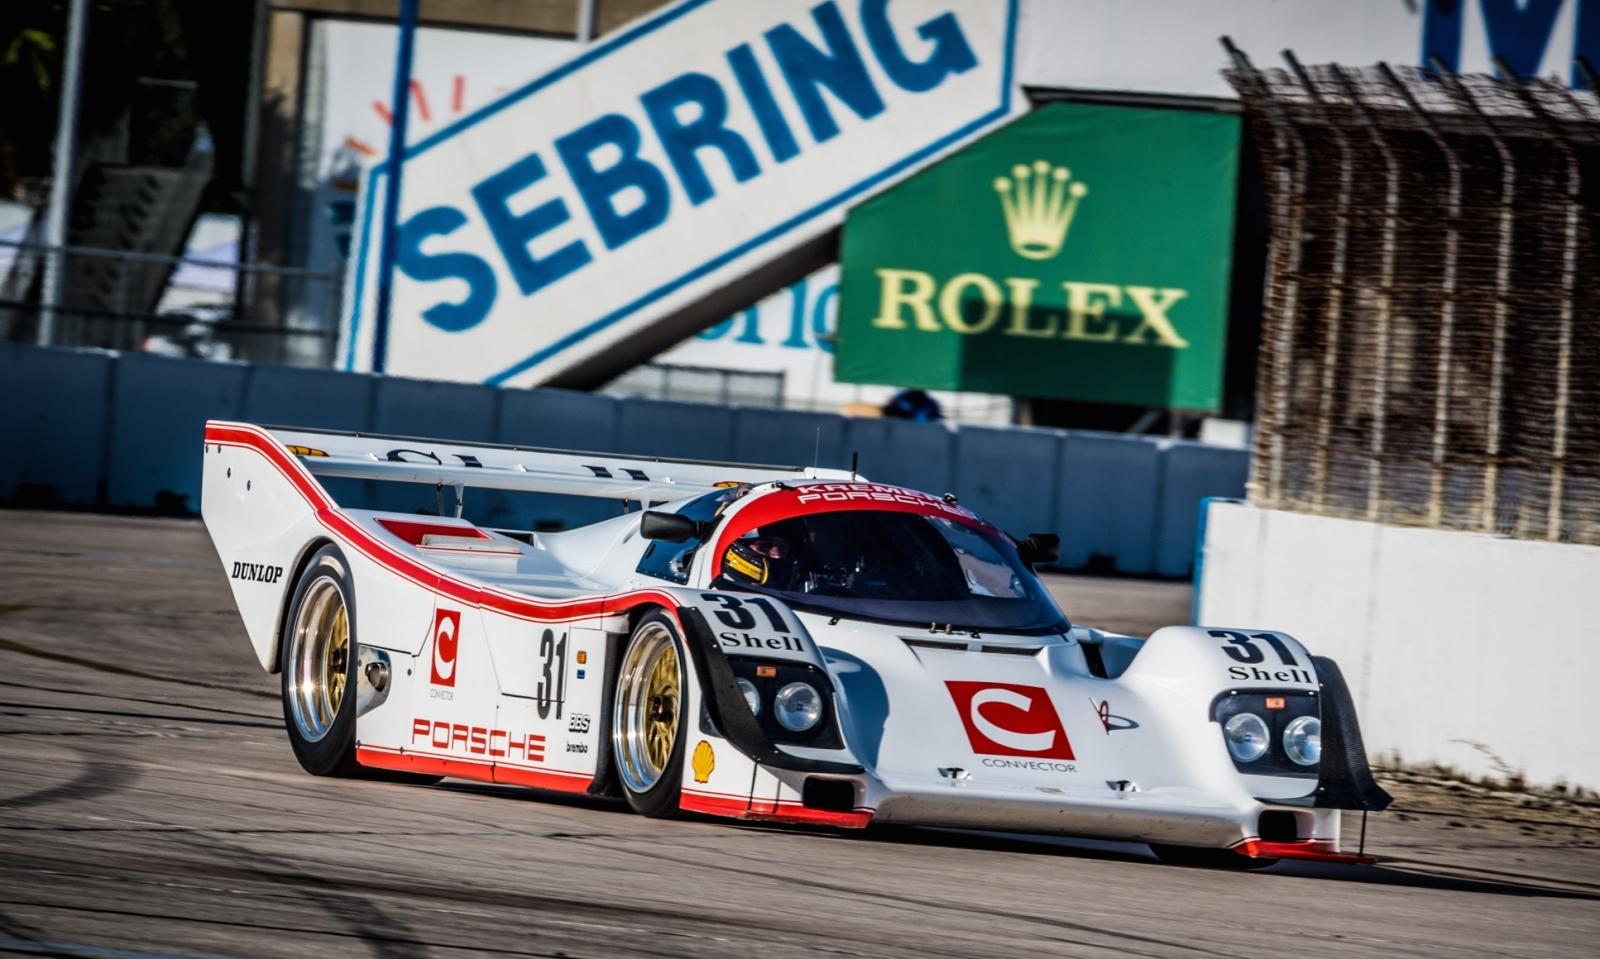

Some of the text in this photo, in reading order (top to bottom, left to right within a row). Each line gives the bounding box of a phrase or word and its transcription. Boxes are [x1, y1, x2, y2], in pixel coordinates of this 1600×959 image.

[392, 0, 979, 333] SEBRING
[872, 268, 1190, 349] ROLEX
[797, 491, 968, 518] PORSCHE
[231, 561, 283, 584] DUNLOP
[700, 593, 790, 634] 31
[719, 632, 806, 652] Shell
[1207, 630, 1299, 667] 31
[537, 628, 567, 720] 31
[1228, 666, 1314, 684] Shell
[568, 713, 591, 734] BBS
[412, 718, 546, 762] PORSCHE
[566, 741, 588, 754] brembo
[981, 758, 1077, 774] CONVECTOR
